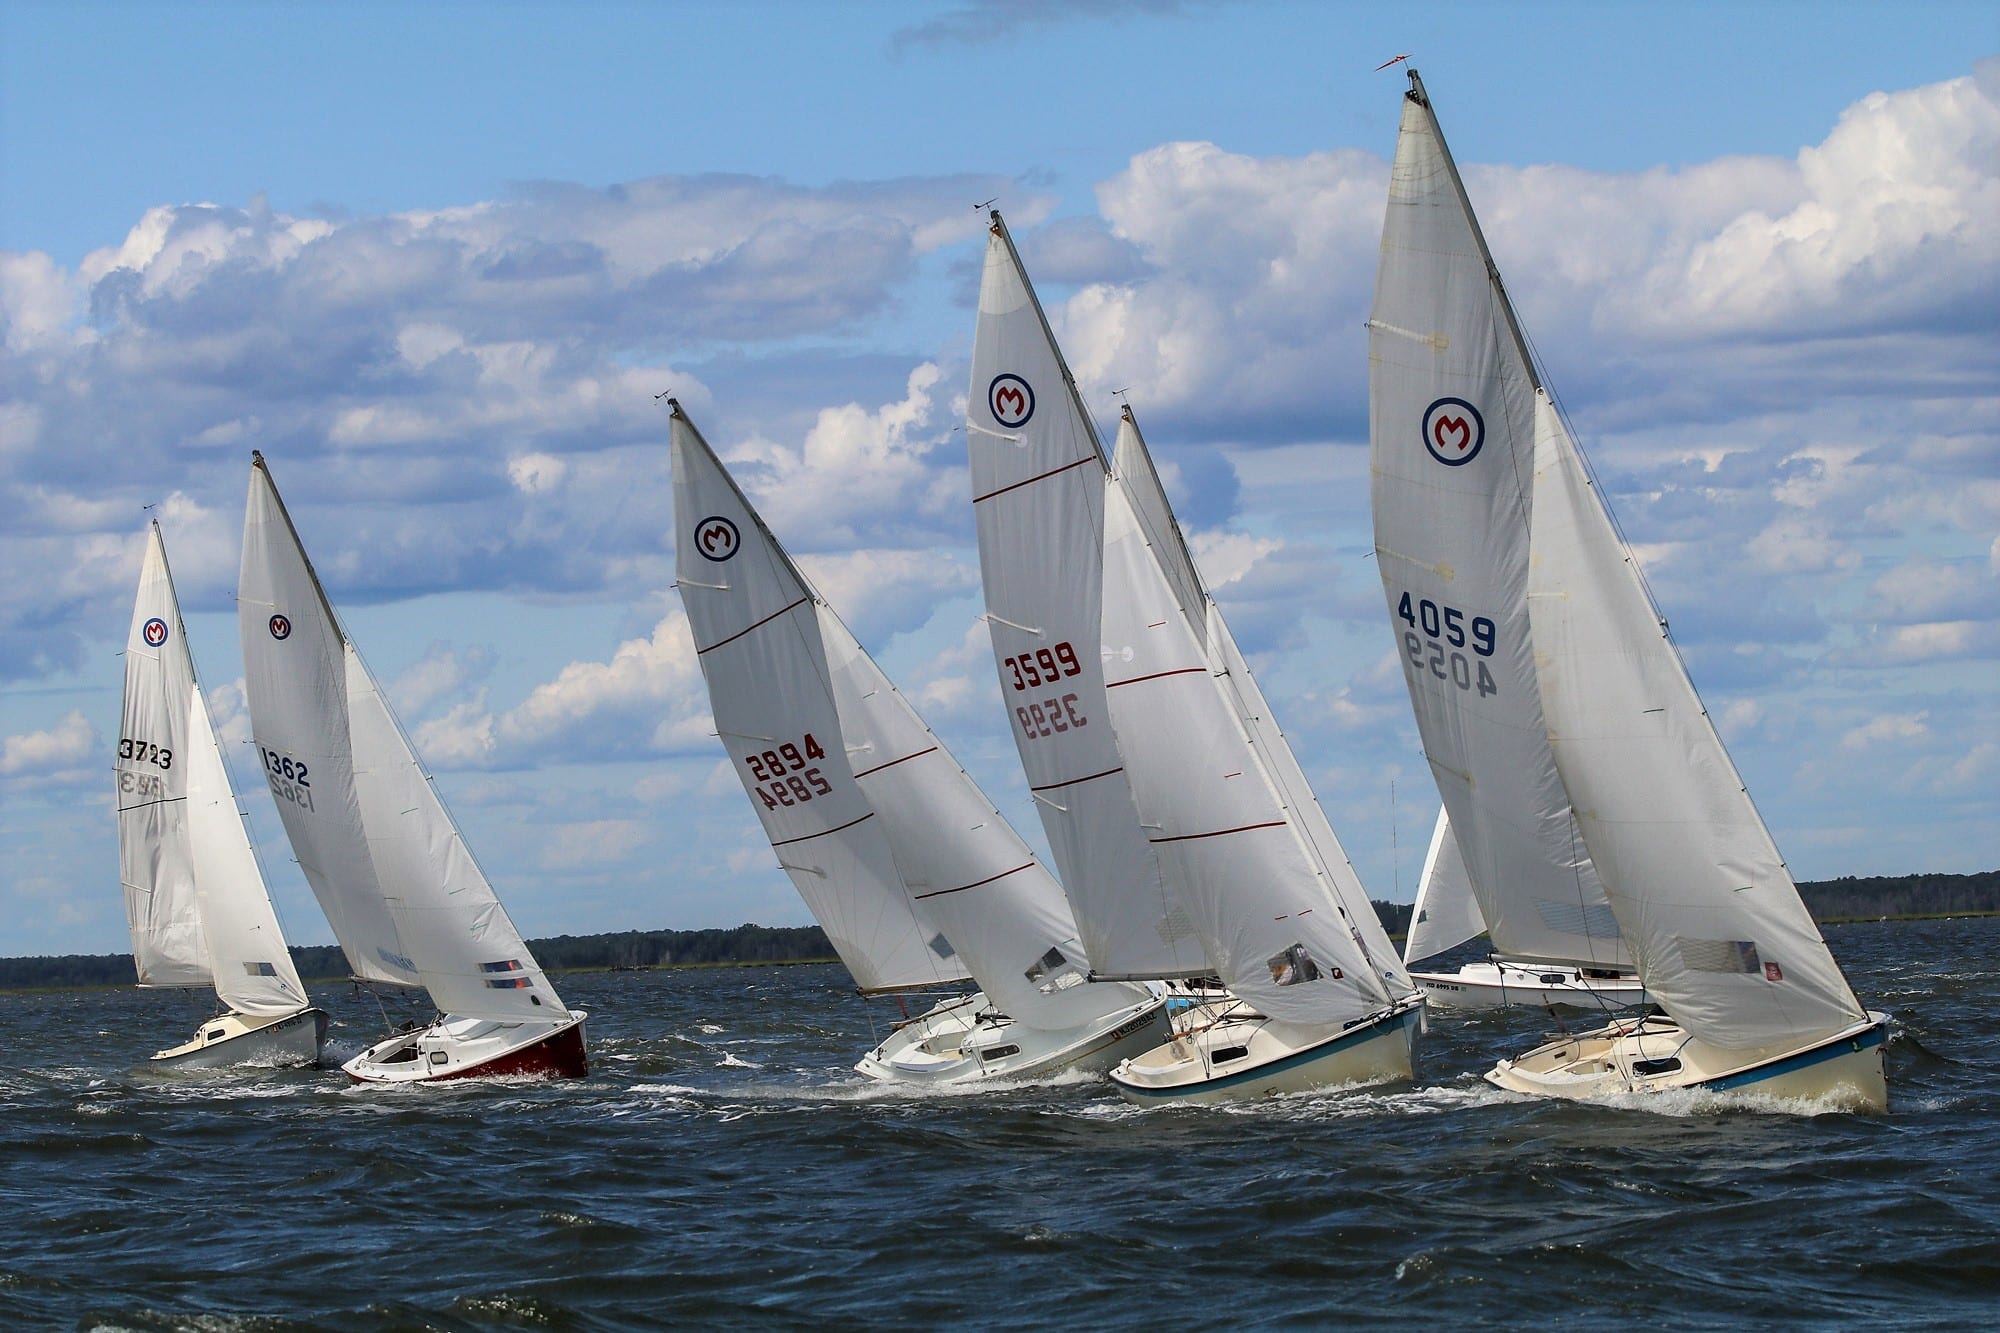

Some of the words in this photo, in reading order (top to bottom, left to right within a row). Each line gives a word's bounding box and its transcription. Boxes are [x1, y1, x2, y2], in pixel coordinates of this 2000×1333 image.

[996, 386, 1025, 417] M
[1434, 415, 1471, 451] M
[1398, 591, 1496, 657] 4059
[1004, 641, 1082, 691] 3599
[119, 738, 173, 770] 3723
[261, 747, 311, 788] 1362
[745, 733, 826, 782] 2894
